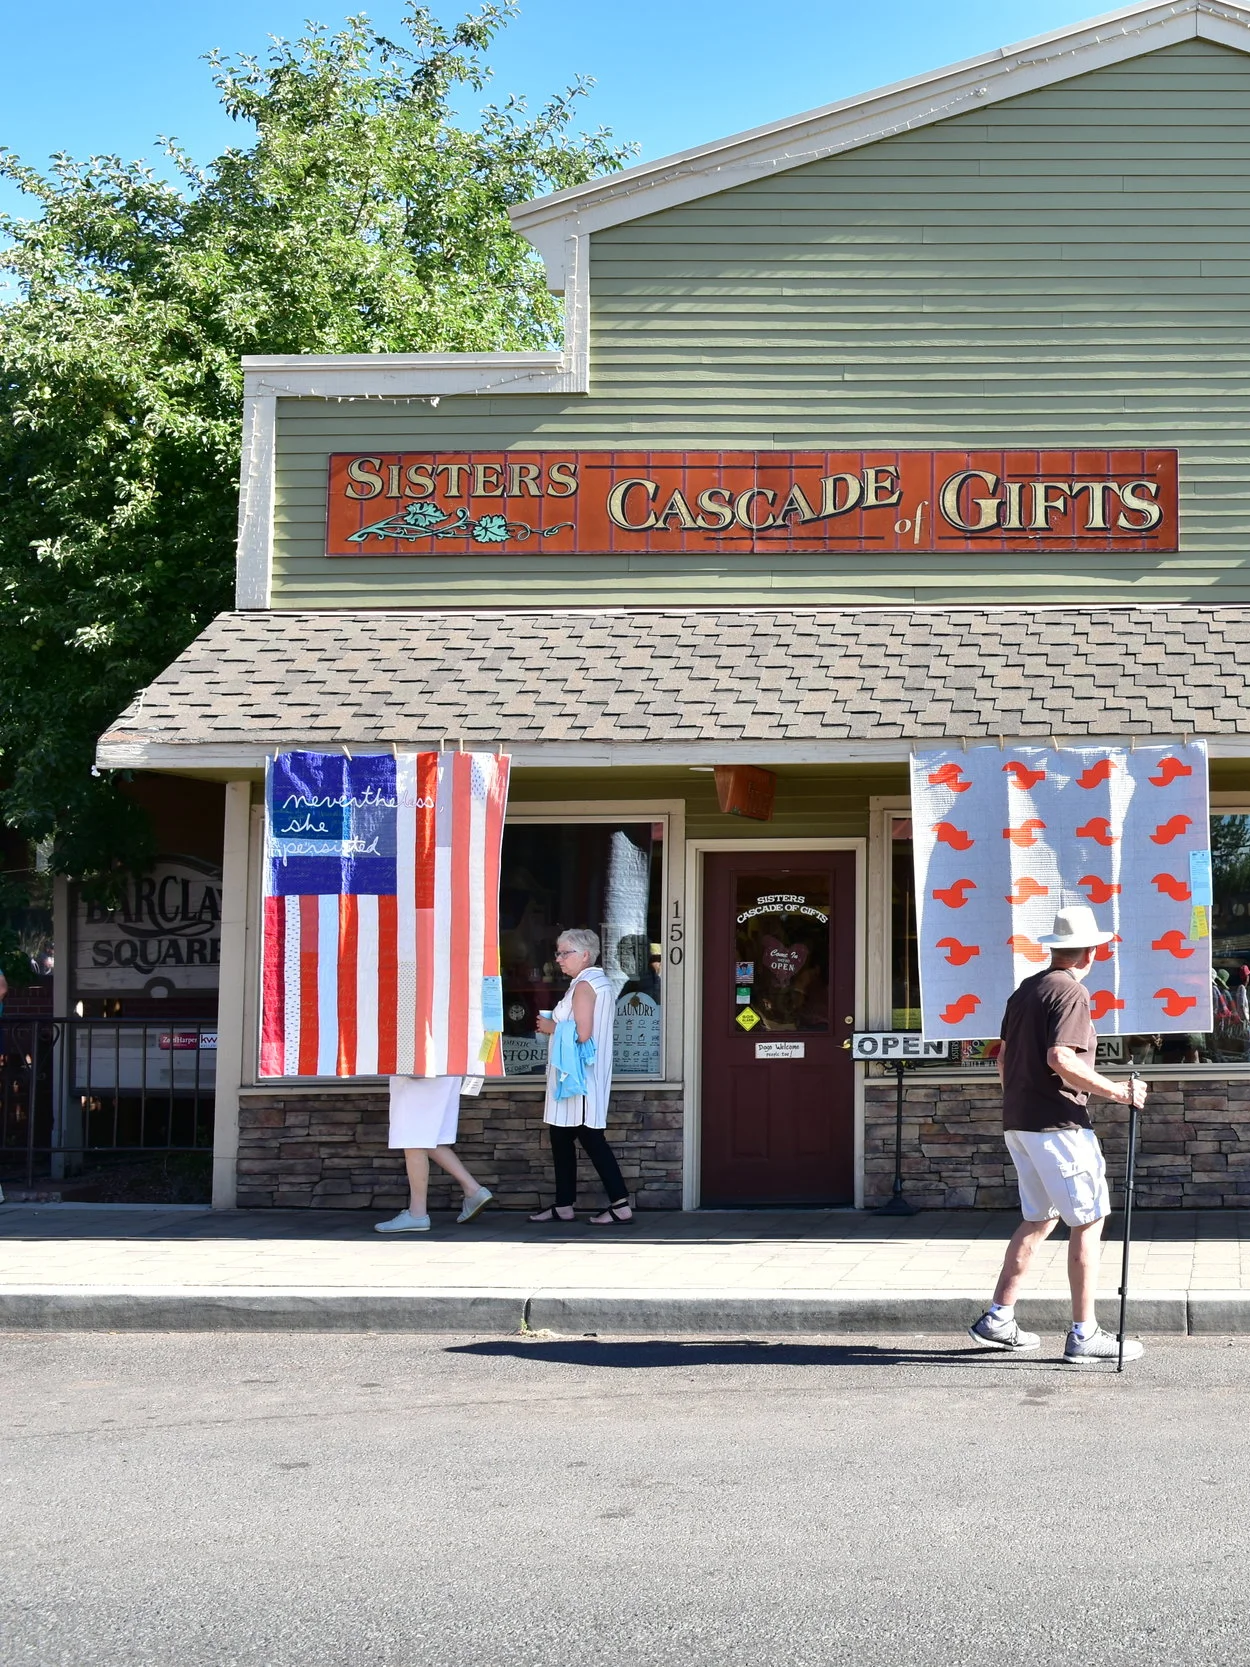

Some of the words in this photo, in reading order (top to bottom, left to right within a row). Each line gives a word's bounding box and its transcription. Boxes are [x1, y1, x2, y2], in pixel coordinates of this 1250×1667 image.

[345, 457, 580, 500] SISTERS
[606, 465, 903, 532] CASCADE
[894, 500, 929, 545] of
[939, 469, 1164, 533] GIFTS
[281, 813, 329, 833] she
[84, 874, 223, 939] BARCLA
[756, 894, 806, 905] SISTERS
[736, 903, 784, 924] CASCADE
[784, 903, 800, 912] OF
[800, 905, 829, 924] GIFTS
[670, 900, 683, 965] 150
[770, 948, 788, 958] Come
[771, 961, 795, 971] OPEN
[617, 1002, 656, 1017] LAUNDRY
[775, 1042, 800, 1051] Welcome
[857, 1036, 944, 1056] OPEN
[503, 1049, 548, 1061] STORE
